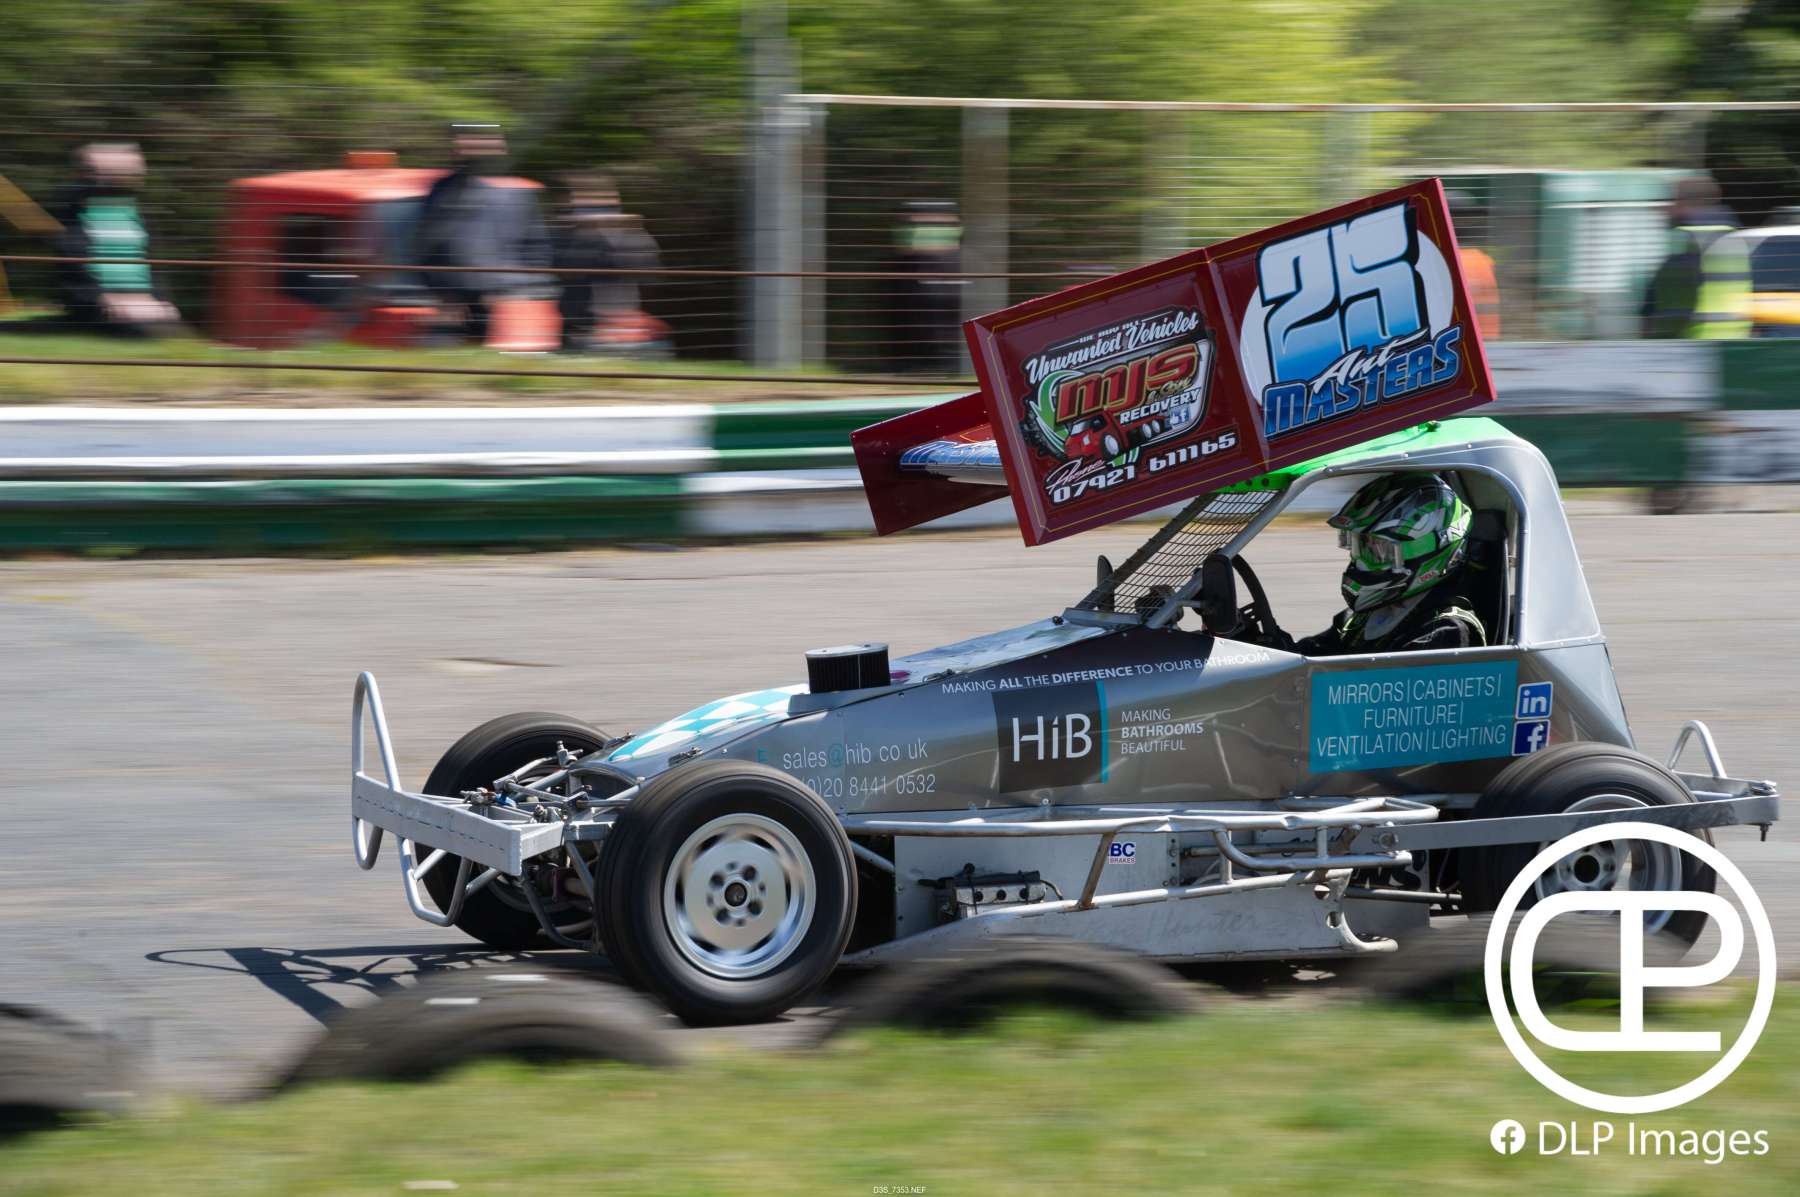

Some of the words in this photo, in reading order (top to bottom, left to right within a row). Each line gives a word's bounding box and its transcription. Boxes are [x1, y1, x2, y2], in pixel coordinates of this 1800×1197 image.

[1258, 203, 1423, 384] 25
[1026, 332, 1122, 384] Unwanted
[1125, 311, 1199, 350] Vehicles
[1313, 328, 1429, 394] Ant
[1263, 326, 1462, 438] MASTERS
[1120, 387, 1201, 425] RECOVERY
[1053, 465, 1136, 503] 07921
[1149, 432, 1237, 473] 611165
[942, 679, 996, 694] MAKING
[1000, 677, 1023, 689] ALL
[1024, 674, 1050, 687] THE
[1052, 666, 1134, 684] DIFFERENCE
[1136, 663, 1154, 675] TO
[1155, 658, 1193, 674] YOUR
[1195, 651, 1271, 669] BATHROOM
[1012, 713, 1093, 762] HiB
[1121, 708, 1171, 722] MAKING
[1121, 722, 1205, 739] BATHROOMS
[1121, 740, 1187, 754] BEAUTIFUL
[849, 776, 887, 797] 8441
[896, 774, 936, 794] 0532
